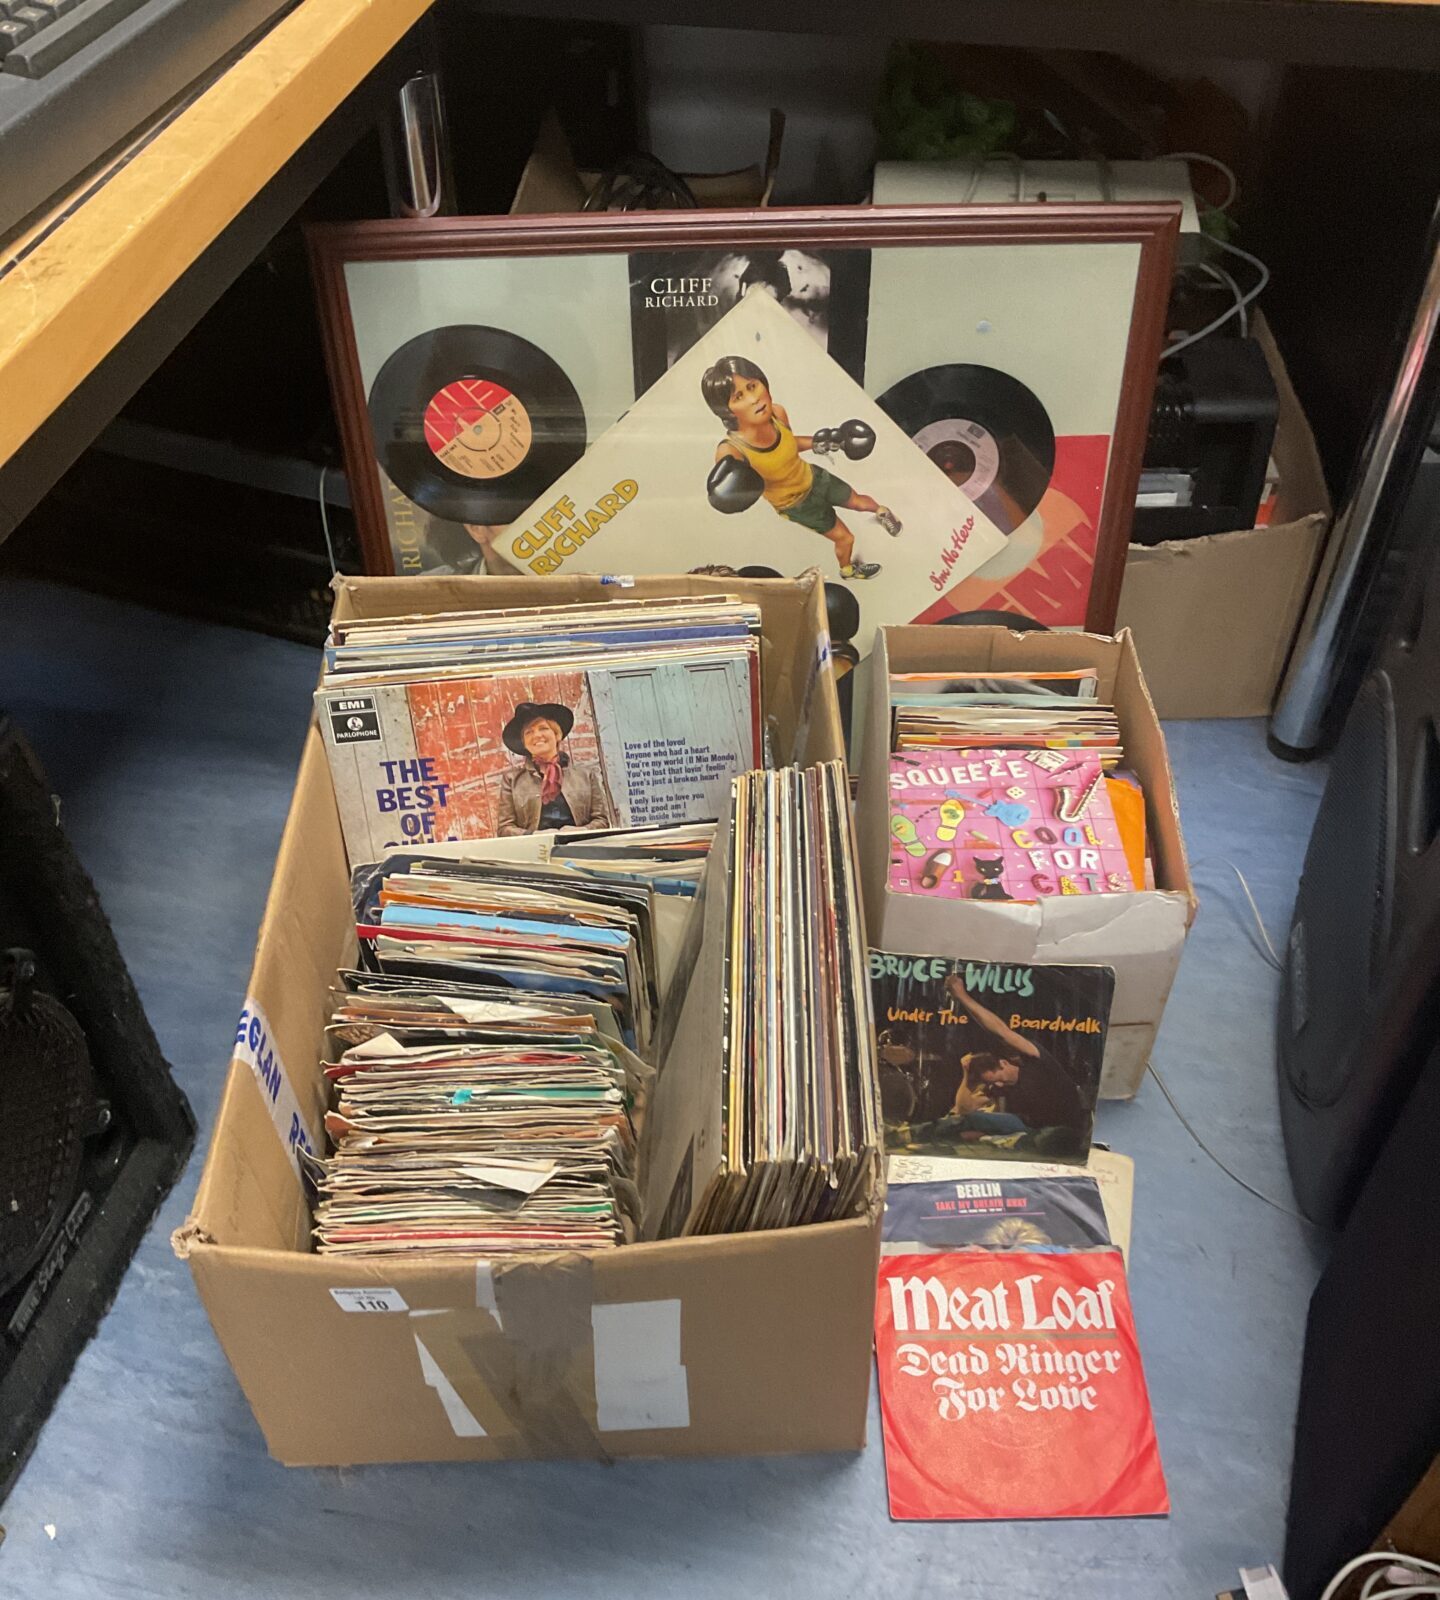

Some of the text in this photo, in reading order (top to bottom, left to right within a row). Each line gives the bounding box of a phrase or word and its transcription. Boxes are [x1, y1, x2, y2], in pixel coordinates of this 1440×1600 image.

[650, 278, 712, 294] CLIFF
[645, 295, 719, 308] RICHARD
[512, 494, 576, 559] CLIFF
[528, 479, 639, 576] RICHARD
[929, 515, 975, 592] I'm No Hero
[339, 700, 365, 711] EMI
[336, 730, 378, 739] PARLOPHONE
[624, 737, 686, 750] Love of the loved
[625, 751, 651, 760] Anyone
[669, 748, 682, 756] had
[690, 745, 710, 754] heart
[379, 758, 439, 784] THE
[626, 759, 649, 769] You're
[664, 757, 683, 765] world
[627, 769, 651, 778] You've
[652, 768, 666, 776] lost
[668, 766, 683, 774] that
[628, 778, 650, 787] Love's
[652, 776, 666, 787] just
[674, 775, 698, 784] broken
[700, 773, 719, 781] heart
[889, 759, 1029, 790] SQUEEZE
[376, 784, 450, 813] BEST
[629, 788, 645, 796] Alfie
[635, 797, 649, 806] only
[651, 795, 663, 803] live
[666, 794, 674, 802] to
[675, 793, 689, 801] love
[692, 793, 705, 801] you
[630, 806, 648, 814] What
[651, 804, 668, 813] good
[400, 812, 436, 837] OF
[631, 815, 647, 823] Step
[649, 813, 669, 821] inside
[1011, 825, 1104, 849] COOL
[1027, 848, 1100, 871] FOR
[869, 954, 1036, 997] BRUCE WILLIS
[887, 1006, 1102, 1034] Under The Boardwalk
[955, 1183, 1003, 1199] BERLIN
[356, 1300, 390, 1311] 110
[886, 1275, 1117, 1331] Meat Loaf
[896, 1343, 1122, 1384] Dead Ringer
[932, 1376, 1099, 1422] For Love
